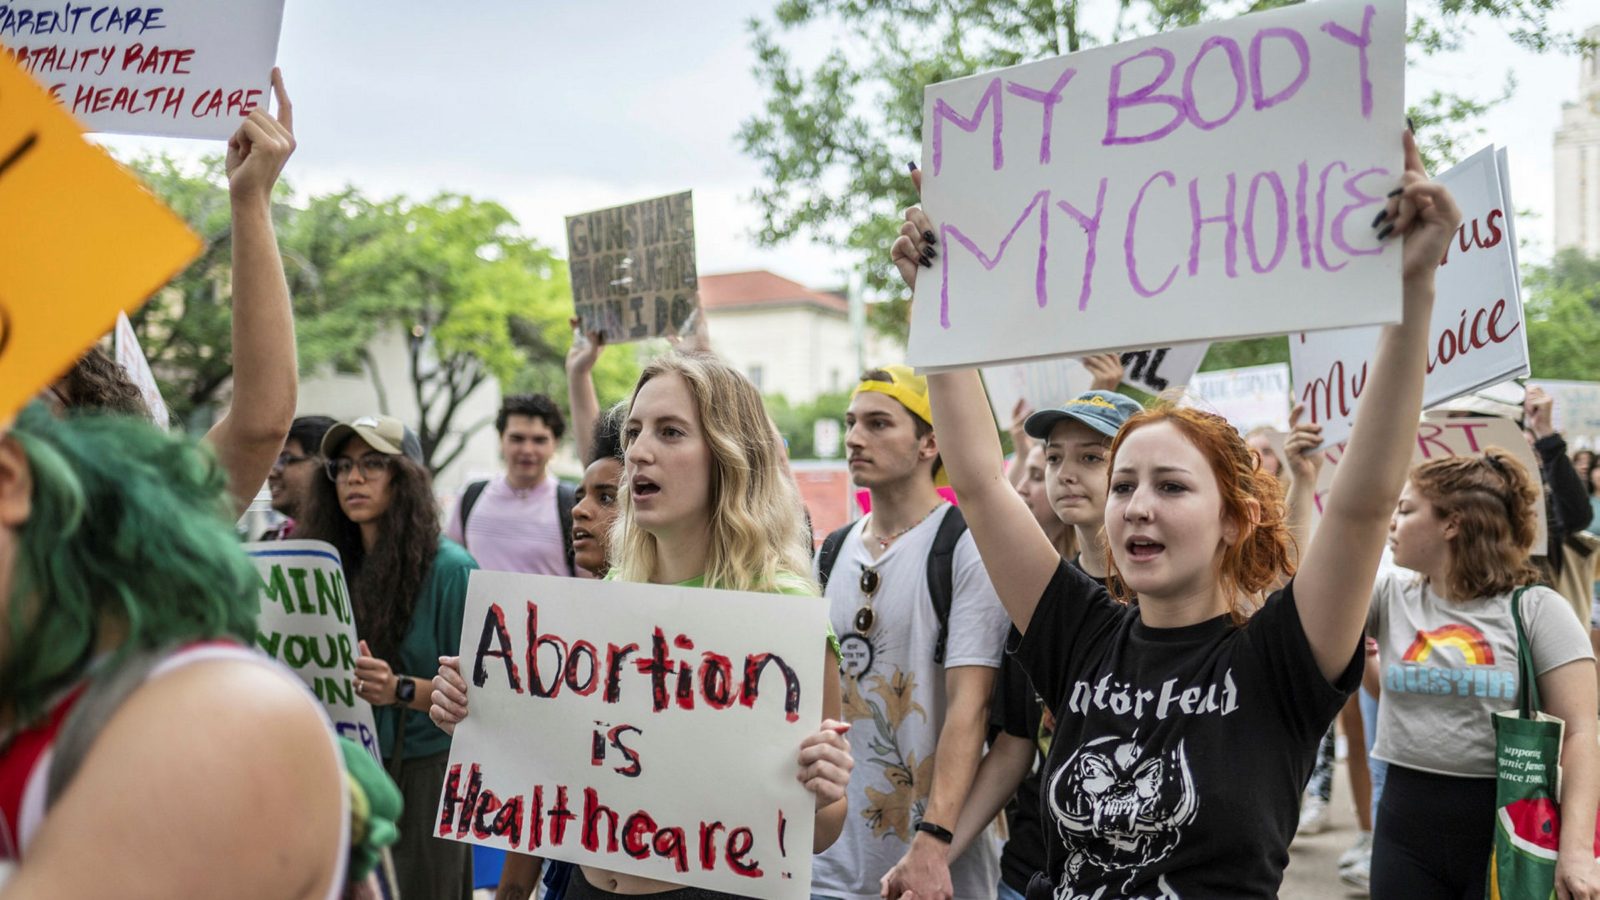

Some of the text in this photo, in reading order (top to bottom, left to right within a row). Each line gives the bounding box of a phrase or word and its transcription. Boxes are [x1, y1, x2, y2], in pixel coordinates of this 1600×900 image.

[90, 7, 166, 35] CARE
[121, 43, 195, 75] RATE
[72, 84, 186, 119] HEALTH
[191, 89, 263, 118] CARE
[932, 4, 1377, 177] MY BODY
[570, 205, 638, 257] GUNS
[938, 159, 1391, 329] MY CHOICE
[629, 296, 648, 338] I
[654, 293, 691, 336] DO
[256, 563, 352, 626] MIND
[256, 630, 357, 672] YOUR
[473, 600, 800, 722] Abortion
[590, 720, 643, 778] is
